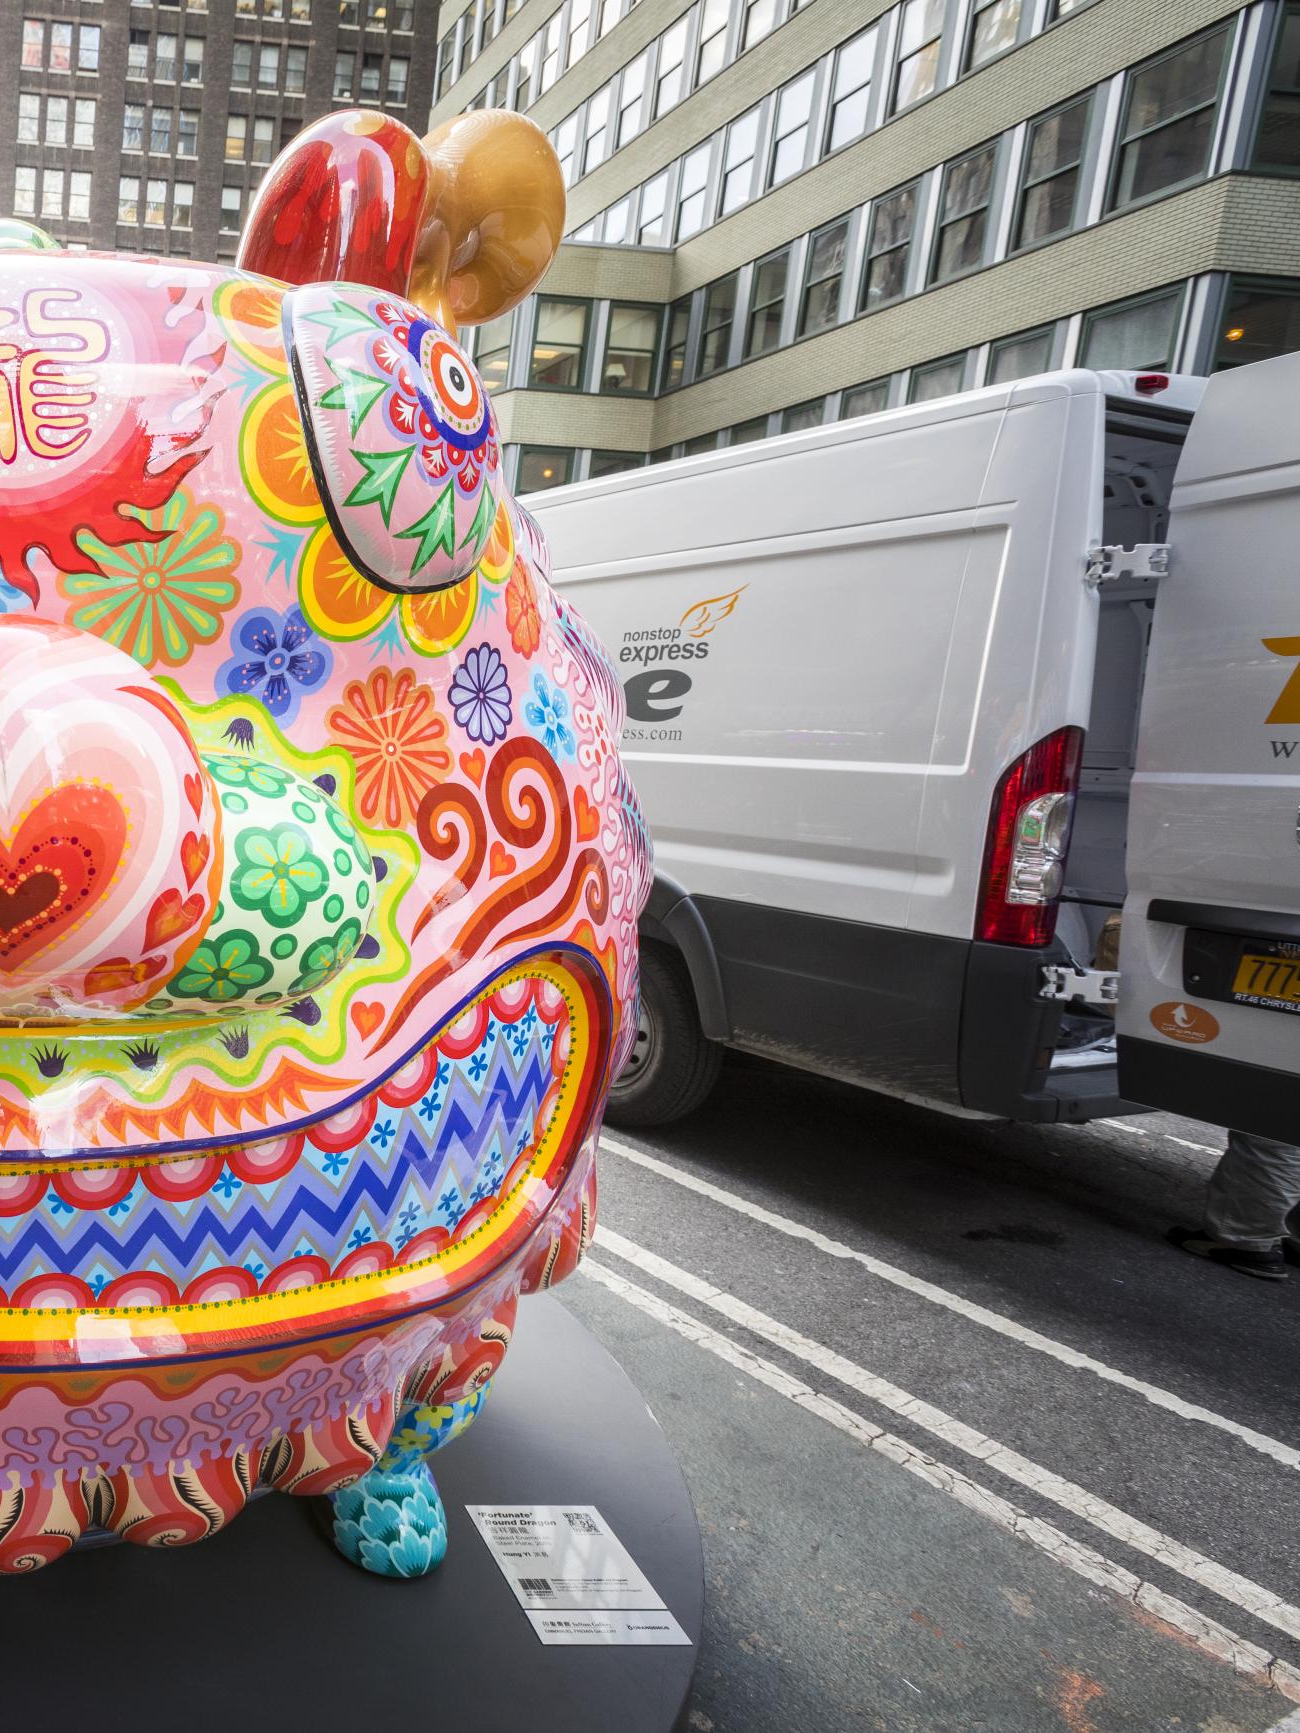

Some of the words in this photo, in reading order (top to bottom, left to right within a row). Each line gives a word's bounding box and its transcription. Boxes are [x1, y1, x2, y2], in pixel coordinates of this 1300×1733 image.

[623, 627, 681, 642] nonstop
[619, 641, 709, 666] express
[1247, 959, 1300, 997] 777
[519, 1519, 557, 1527] Dragon
